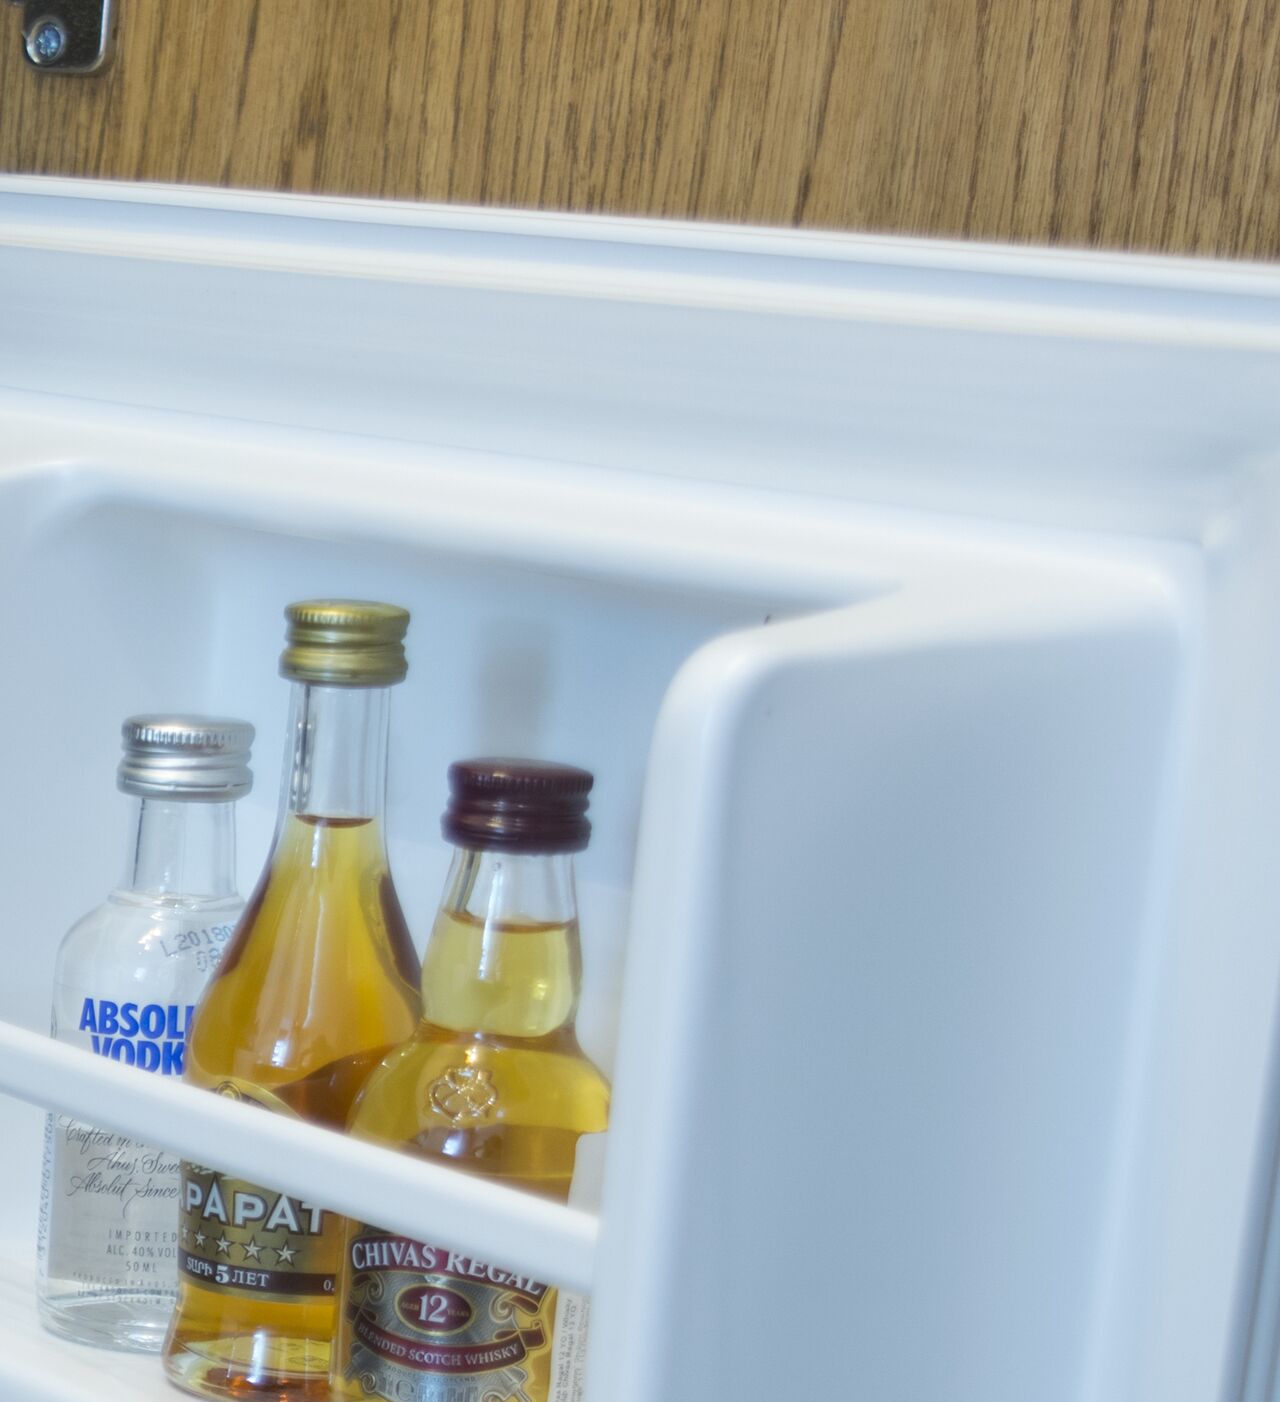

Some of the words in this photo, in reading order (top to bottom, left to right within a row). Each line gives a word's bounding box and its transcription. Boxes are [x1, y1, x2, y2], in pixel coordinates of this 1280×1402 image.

[78, 997, 196, 1040] ABSOL
[90, 1035, 186, 1076] VODK
[66, 1172, 140, 1202] Absolut
[185, 1177, 322, 1235] РАРАТ
[105, 1243, 129, 1257] ALC.
[108, 1227, 178, 1244] IMPORTED
[215, 1264, 230, 1284] 5
[231, 1271, 271, 1288] ЛЕТ
[351, 1240, 437, 1269] CHIVAS
[445, 1251, 540, 1295] REGAL
[417, 1293, 448, 1324] 12
[358, 1325, 406, 1357] BLENDED
[407, 1349, 462, 1367] SCOTCH
[464, 1342, 519, 1366] WHISKY
